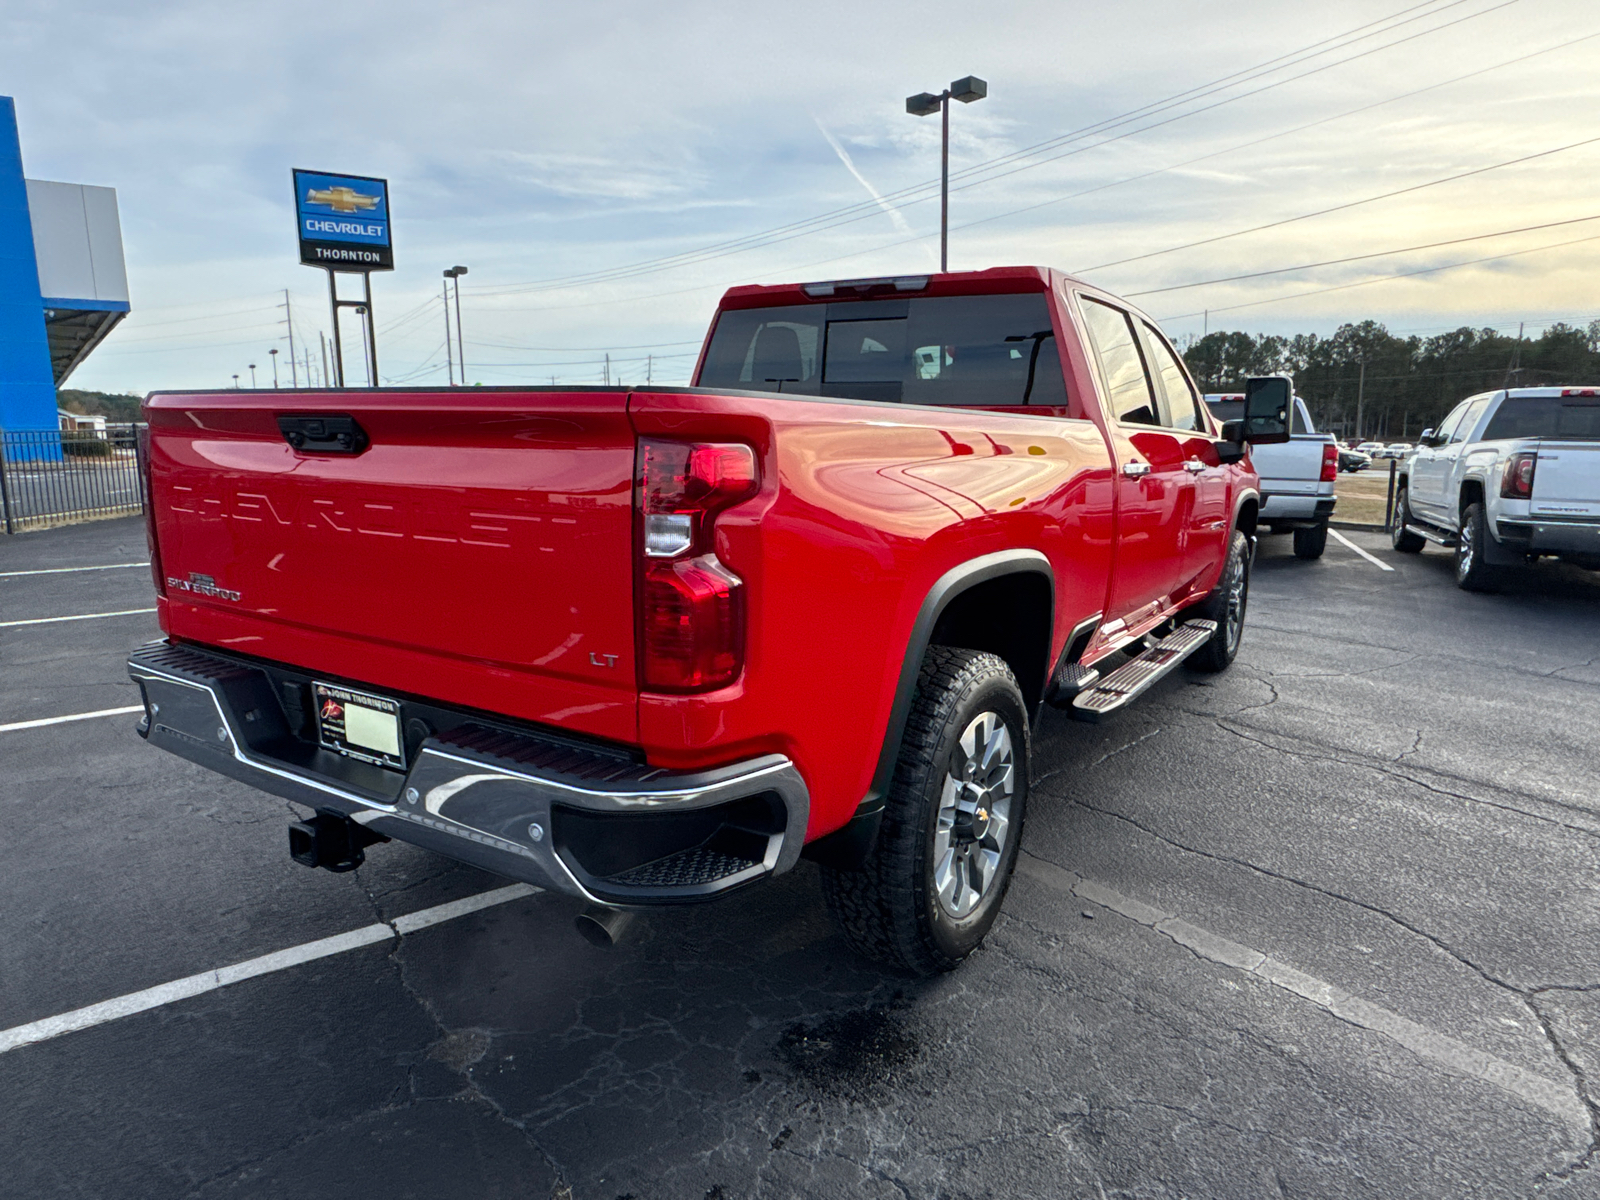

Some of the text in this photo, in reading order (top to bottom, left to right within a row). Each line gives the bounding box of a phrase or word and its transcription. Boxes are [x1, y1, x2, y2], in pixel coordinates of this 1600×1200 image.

[306, 220, 383, 236] CHEVROLET
[315, 247, 380, 262] THORNTON
[170, 485, 577, 552] CHEVROLET
[589, 652, 619, 667] LT
[331, 689, 351, 700] JOHN
